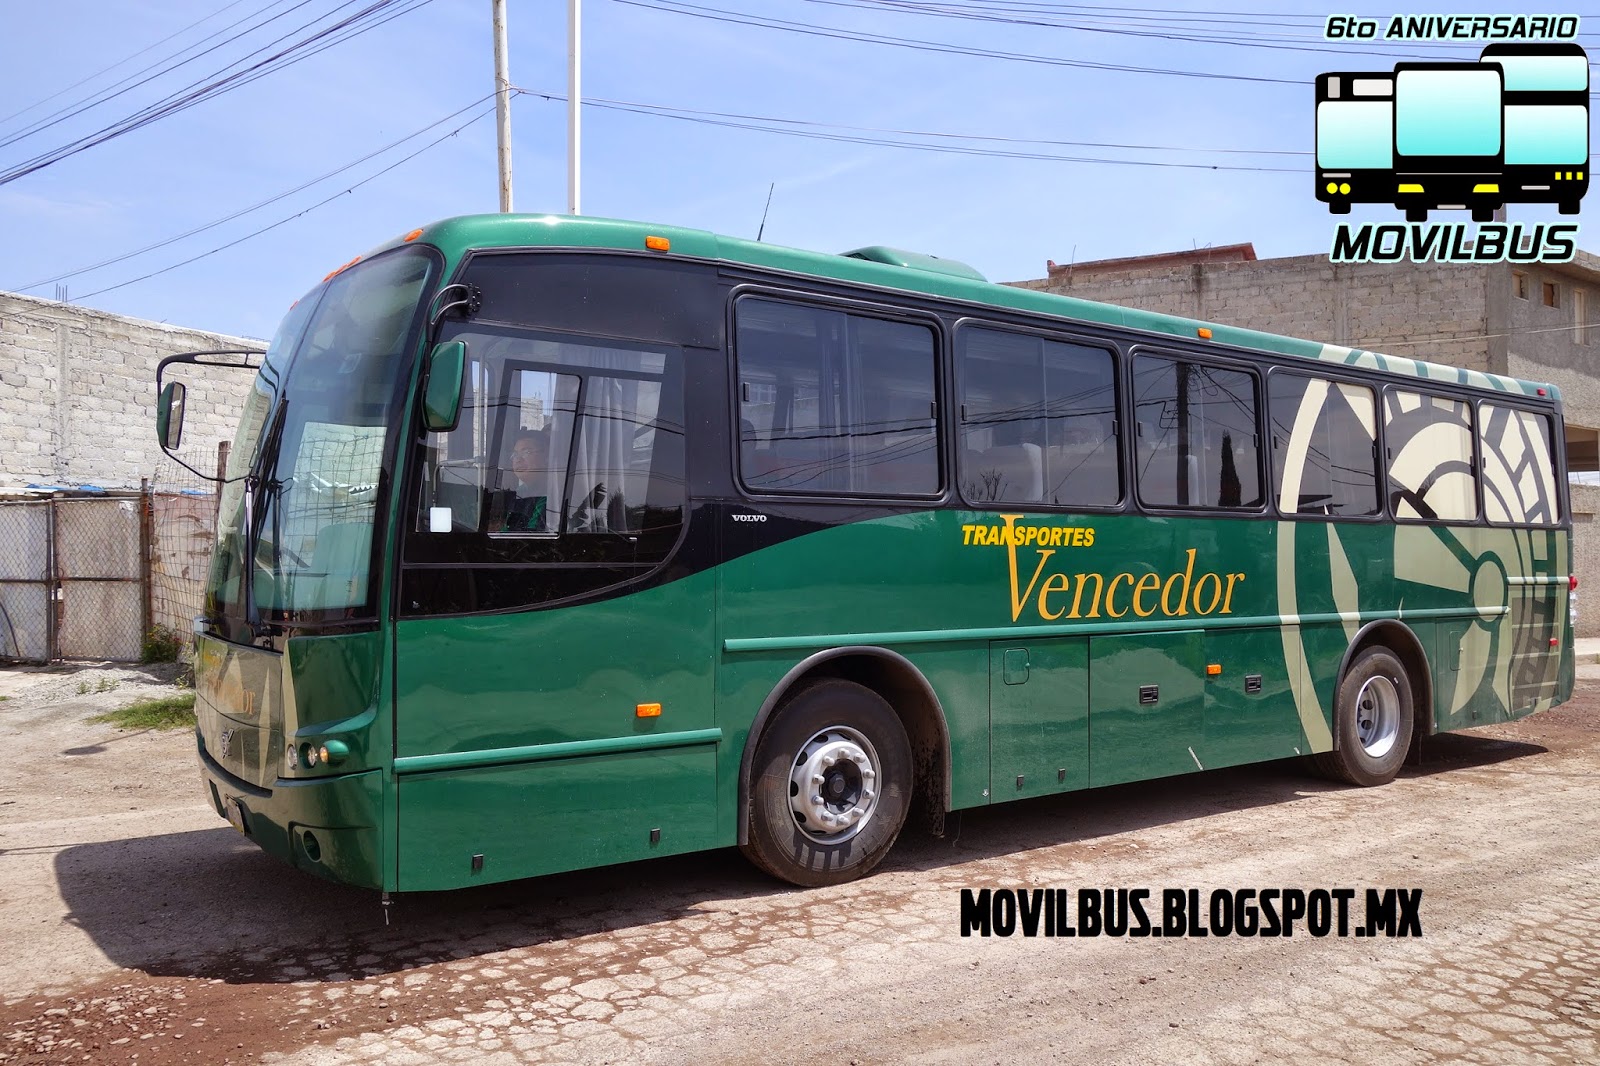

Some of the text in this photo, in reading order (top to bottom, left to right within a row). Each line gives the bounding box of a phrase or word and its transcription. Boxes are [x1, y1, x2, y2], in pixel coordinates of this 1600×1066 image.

[731, 514, 768, 523] VOLVO
[961, 525, 1096, 547] TRANSPORTES
[999, 514, 1246, 623] Vencedor
